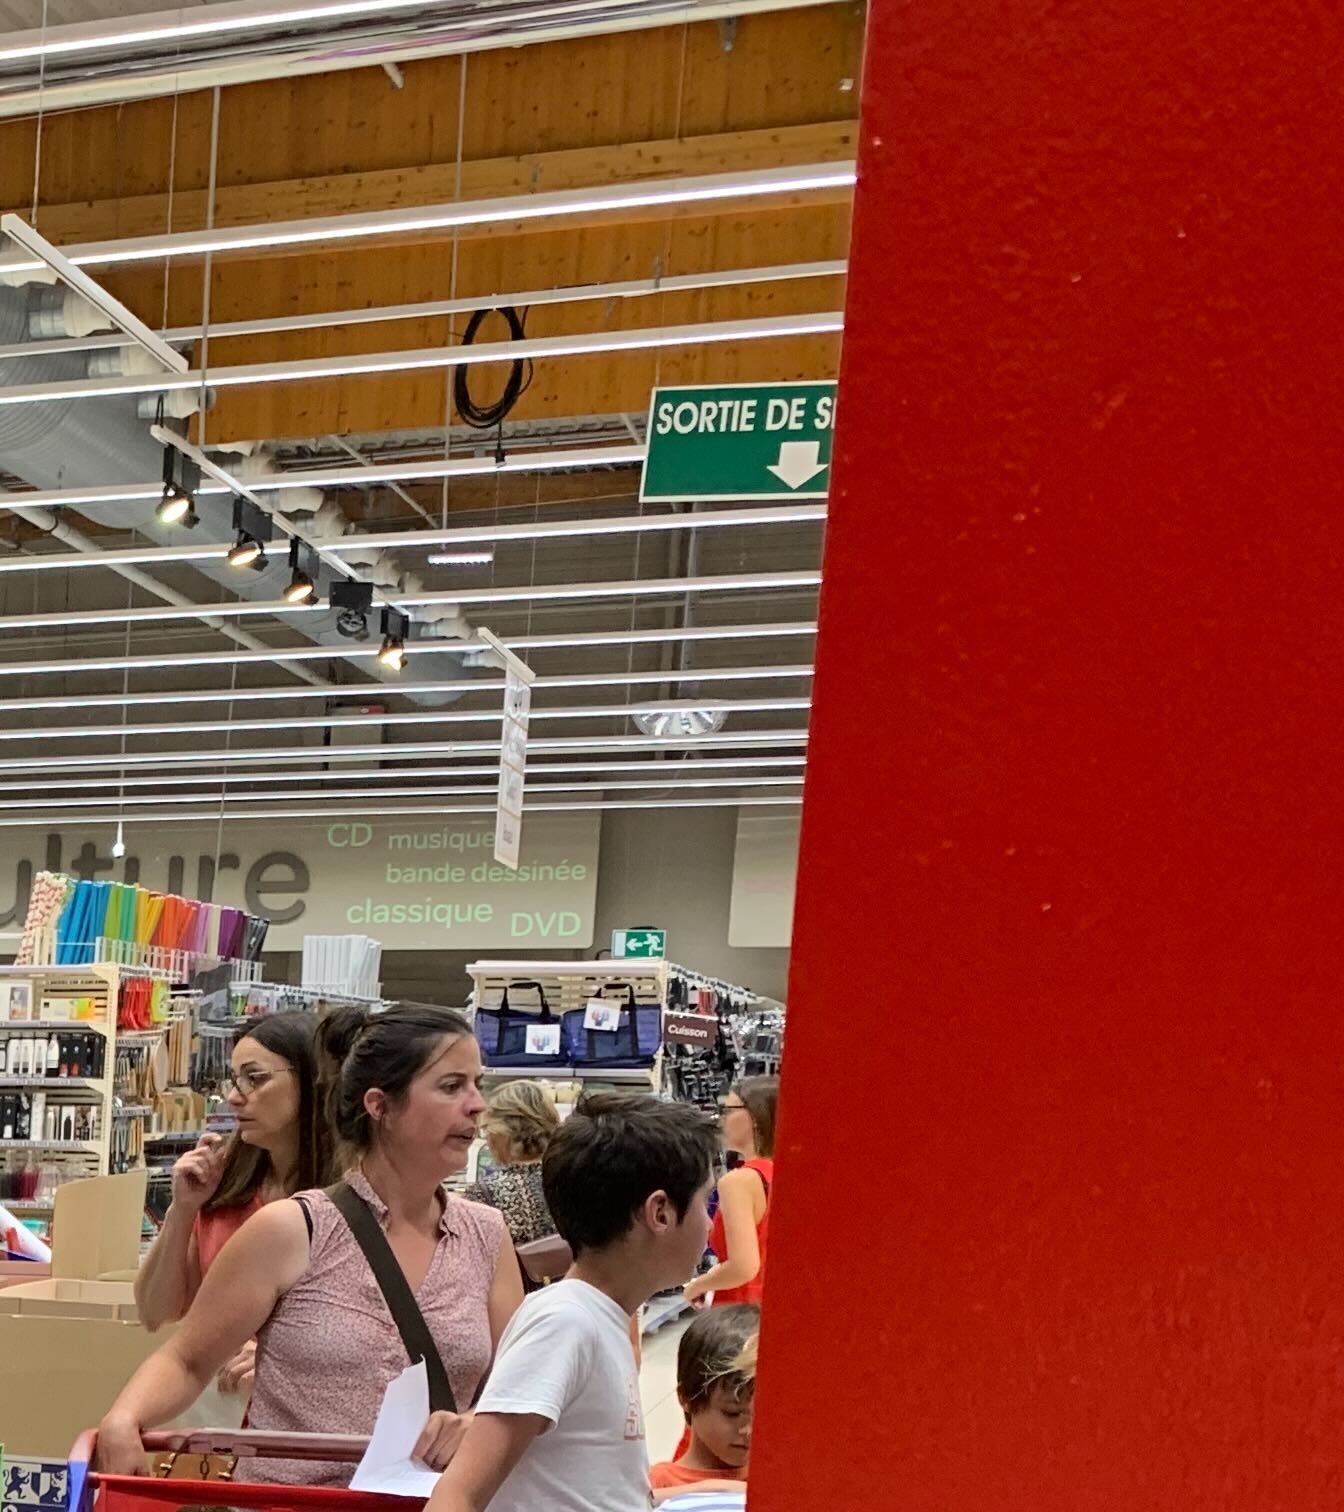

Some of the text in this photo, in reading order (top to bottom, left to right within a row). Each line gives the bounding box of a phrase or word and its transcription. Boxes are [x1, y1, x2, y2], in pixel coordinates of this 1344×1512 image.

[656, 398, 758, 435] SORTIE
[765, 397, 807, 432] DE
[327, 822, 373, 848] CD
[388, 826, 496, 853] musique
[386, 858, 587, 884] bande dessinée
[346, 898, 494, 929] classique
[511, 911, 582, 937] DVD
[667, 1024, 708, 1039] Cuisson
